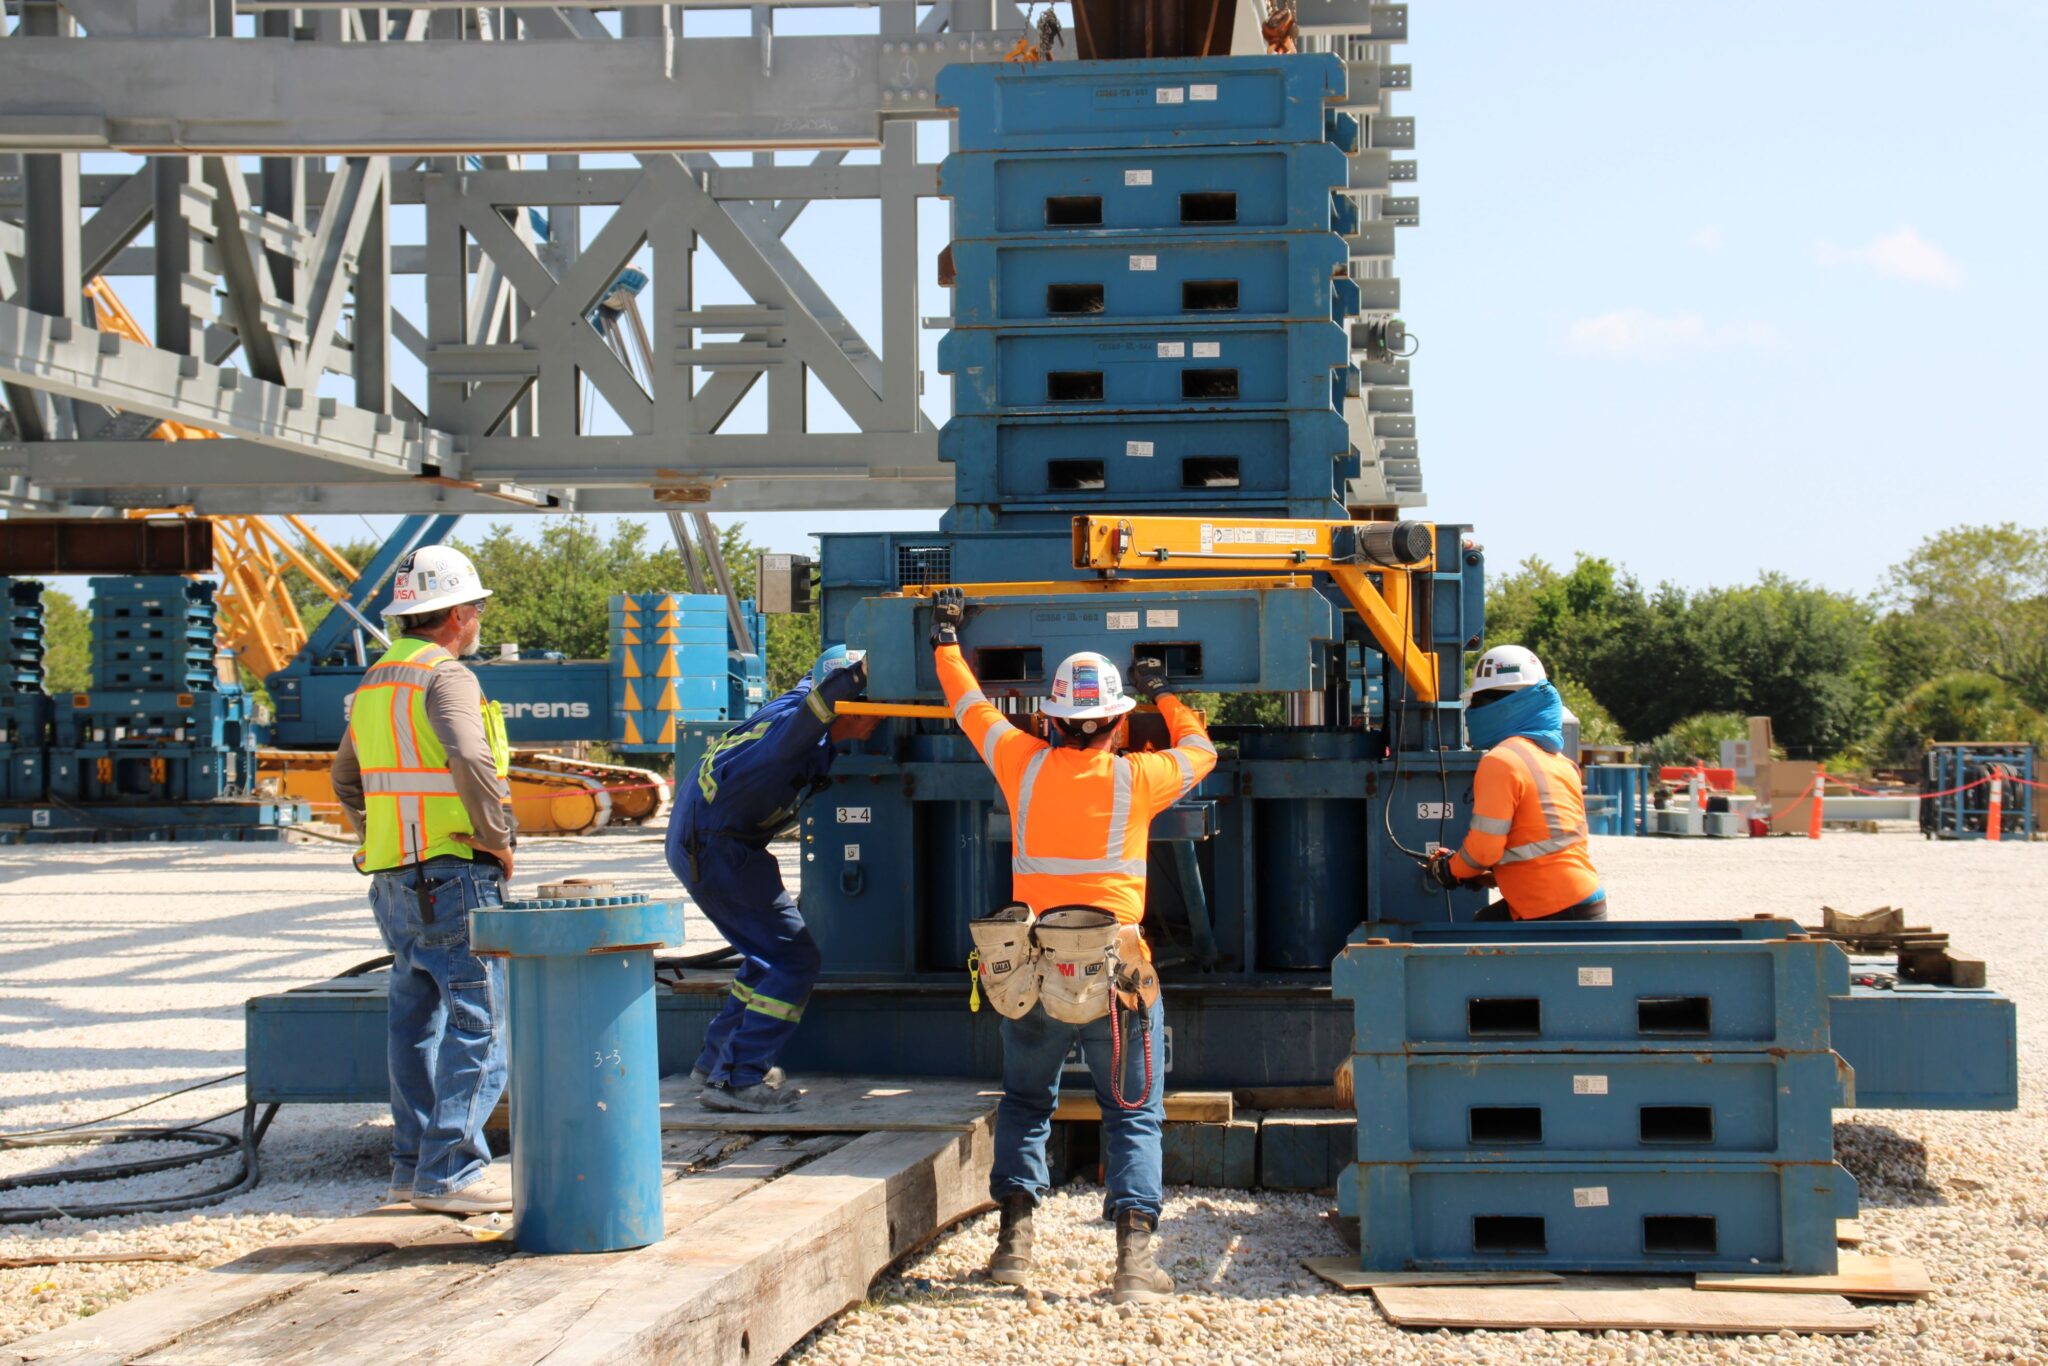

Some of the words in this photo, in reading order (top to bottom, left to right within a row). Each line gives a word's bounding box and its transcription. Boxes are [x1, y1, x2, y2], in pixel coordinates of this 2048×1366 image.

[500, 702, 590, 718] arens
[838, 808, 870, 823] 3-4
[593, 1049, 622, 1068] 3-3
